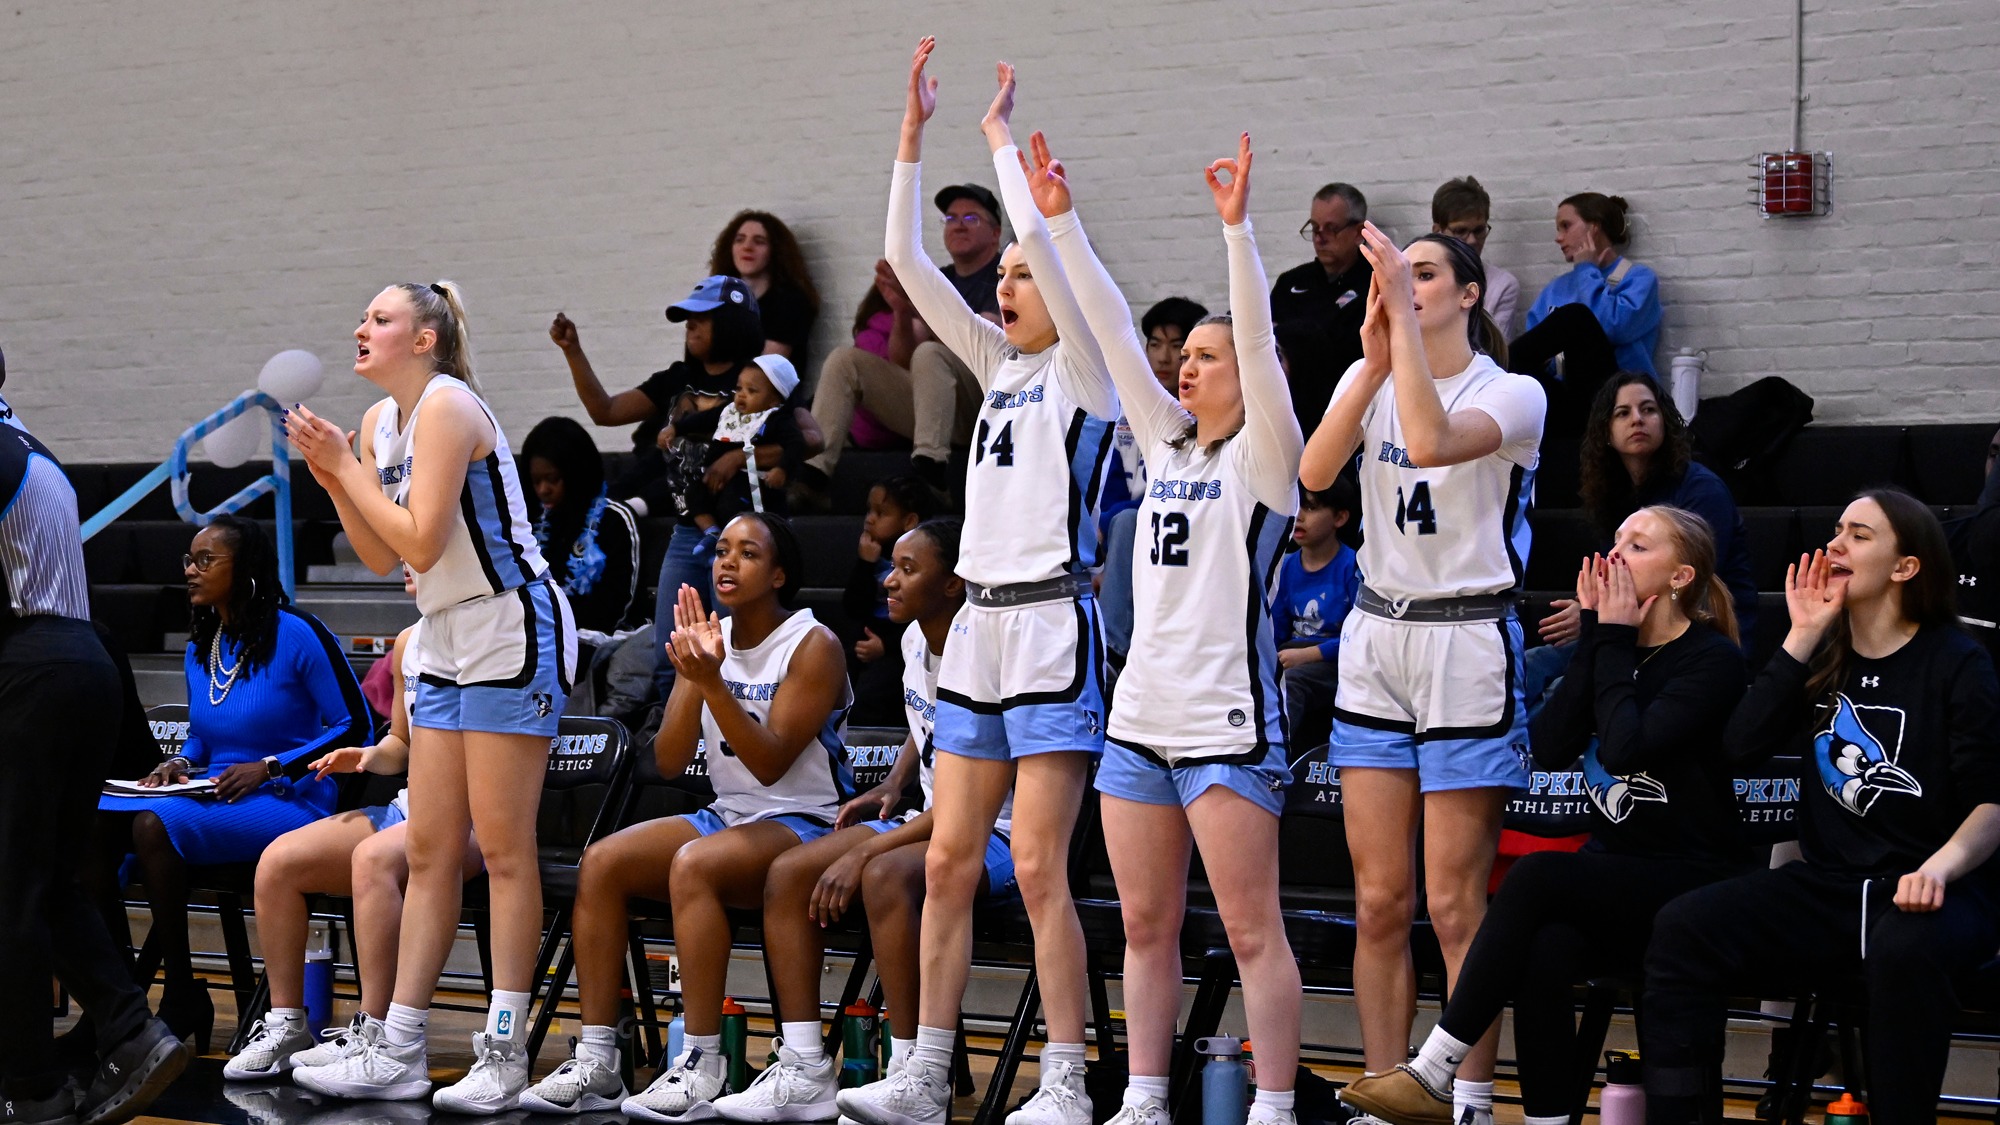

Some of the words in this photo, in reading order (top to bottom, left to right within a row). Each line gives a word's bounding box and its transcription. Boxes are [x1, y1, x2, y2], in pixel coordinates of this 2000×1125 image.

[1150, 511, 1190, 567] 32
[548, 733, 609, 755] PKINS
[548, 759, 593, 771] LETICS
[1505, 800, 1591, 814] THLETIC
